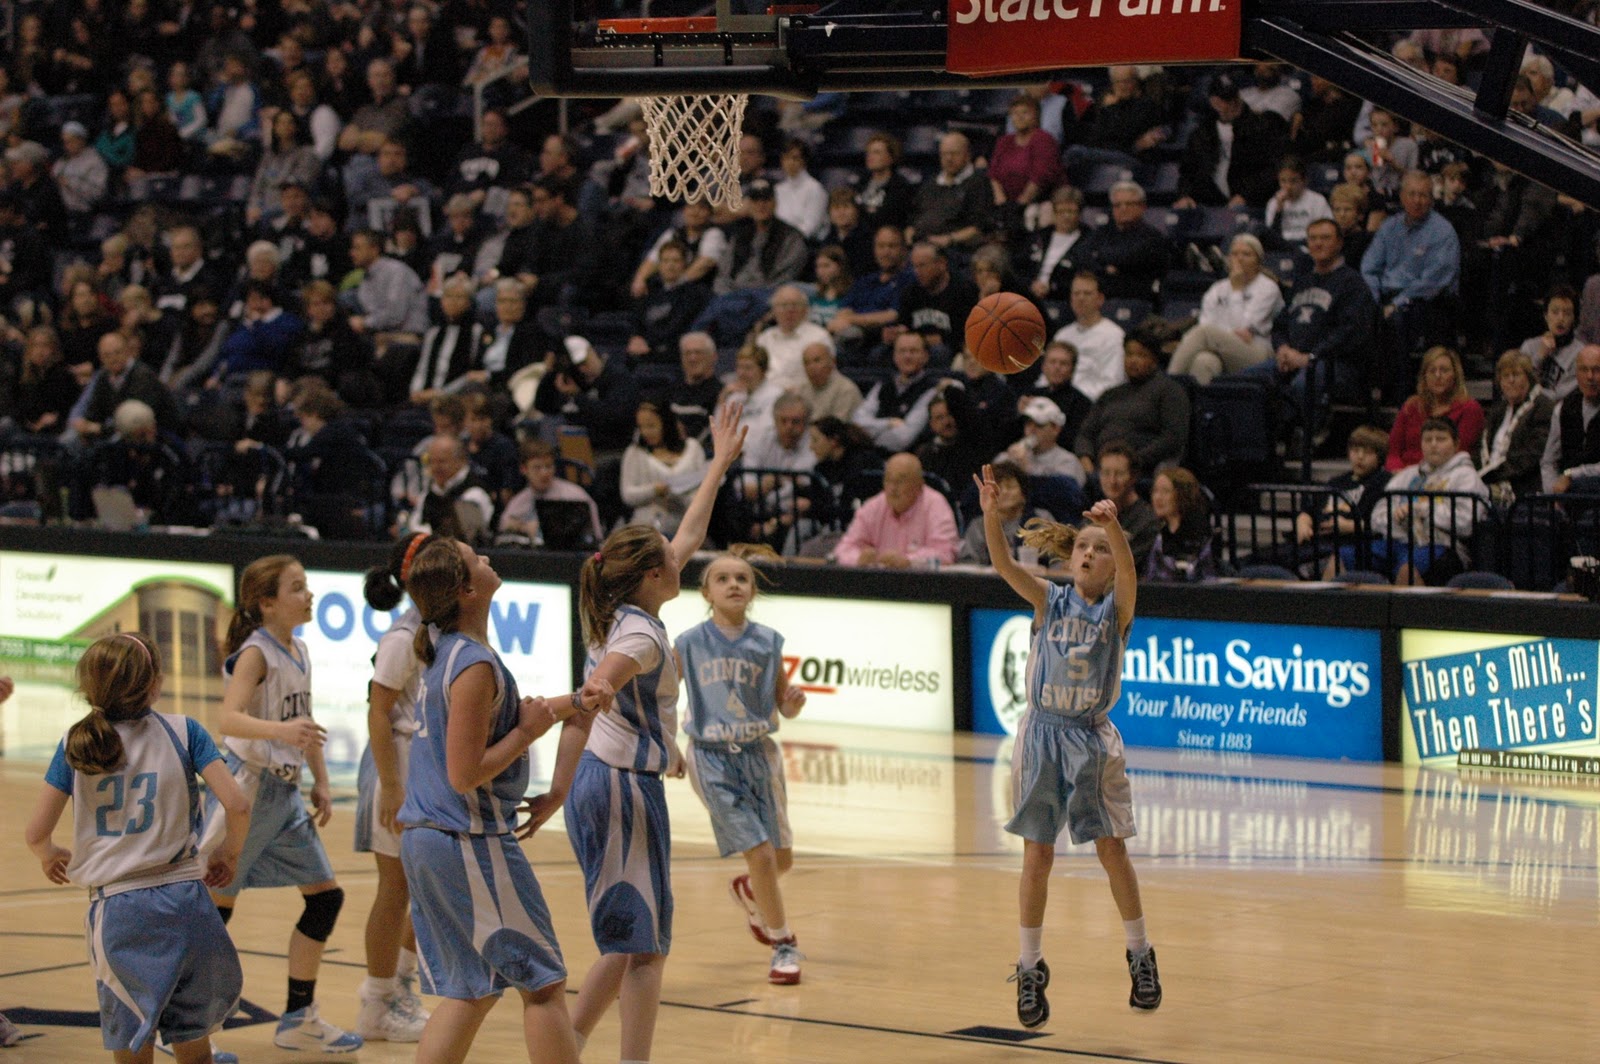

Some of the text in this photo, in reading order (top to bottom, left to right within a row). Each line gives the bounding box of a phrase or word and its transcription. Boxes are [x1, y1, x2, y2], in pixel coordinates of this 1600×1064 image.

[1047, 616, 1110, 643] CINCY
[700, 657, 763, 687] CINCY
[847, 660, 941, 694] wireless
[1067, 646, 1091, 680] 5
[1225, 639, 1371, 708] Savings
[1407, 641, 1586, 704] There's Milk...
[726, 688, 747, 719] 4
[1127, 691, 1308, 727] Your Money Friends
[1414, 688, 1593, 756] Then There's
[1178, 729, 1252, 750] Since 1883
[96, 772, 158, 837] 23
